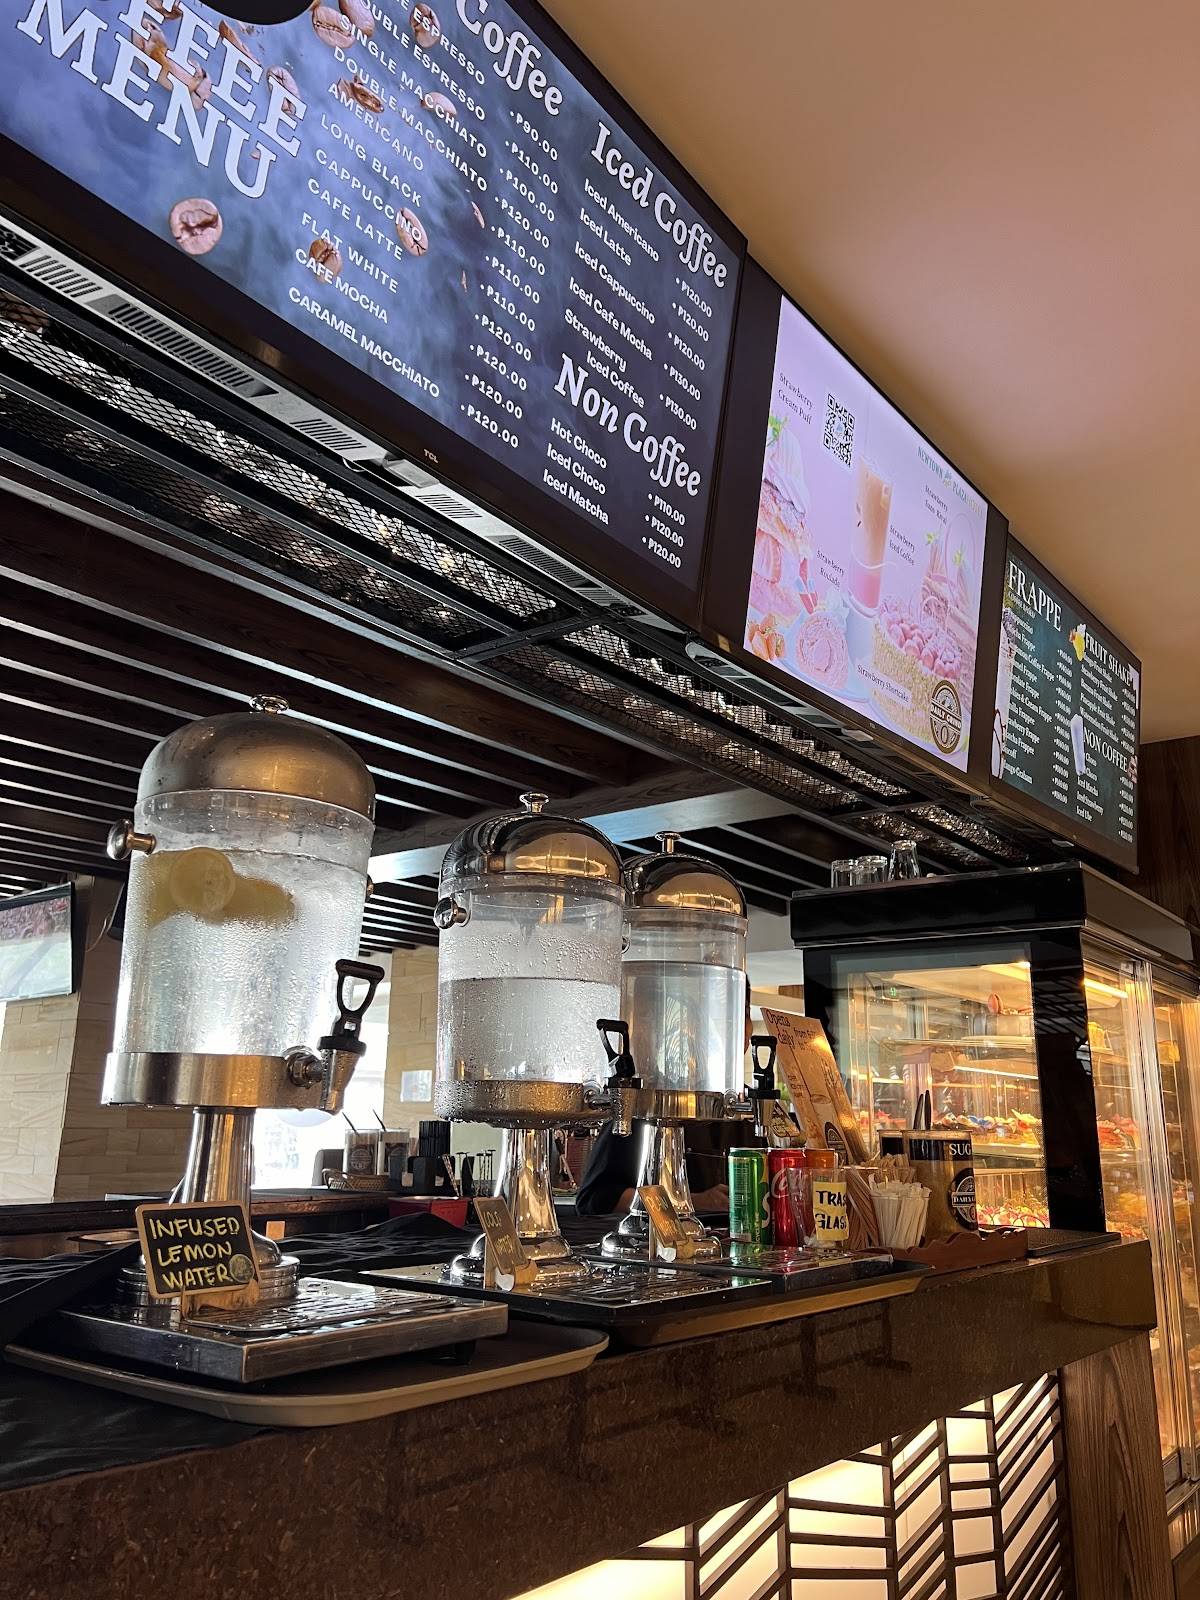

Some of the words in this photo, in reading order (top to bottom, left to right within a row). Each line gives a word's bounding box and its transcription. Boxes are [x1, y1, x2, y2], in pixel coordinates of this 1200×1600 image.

[413, 7, 485, 85] ESPRESSO
[456, 0, 563, 116] Coffee
[17, 0, 277, 198] MENU
[340, 14, 397, 74] SINGLE
[401, 71, 487, 158] MACCHIATO
[413, 45, 486, 121] ESPRESSO
[328, 83, 424, 171] AMERICANO
[333, 46, 397, 111] DOUBLE
[401, 109, 488, 192] MACCHIATO
[320, 113, 367, 161] LONG
[371, 158, 422, 208] BLACK
[307, 178, 351, 220] CAFE
[355, 215, 403, 260] LATTE
[315, 149, 422, 242] CAPPUCCINO
[584, 178, 608, 211] Iced
[607, 204, 660, 262] Americano
[591, 121, 655, 208] Iced
[654, 192, 728, 288] Coffee
[301, 212, 344, 250] FLAT
[348, 246, 399, 295] WHITE
[579, 208, 603, 239] Iced
[603, 230, 632, 266] Latte
[295, 248, 334, 285] CAFE
[335, 277, 389, 324] MOCHA
[574, 241, 598, 271] Iced
[598, 263, 655, 324] Cappuccino
[288, 287, 358, 344] CARAMEL
[360, 335, 440, 398] MACCHIATO
[564, 308, 627, 373] Strawberry
[569, 276, 593, 306] Iced
[594, 299, 620, 331] Cafe
[620, 321, 653, 361] Mocha
[586, 350, 609, 379] Iced
[609, 371, 645, 409] Coffee
[778, 389, 798, 413] Cream
[799, 407, 812, 425] Puff
[779, 372, 813, 410] Strawberry
[550, 417, 573, 444] Hot
[573, 435, 607, 469] Choco
[553, 352, 620, 433] Non
[623, 412, 701, 497] Coffee
[423, 448, 439, 464] TCL
[546, 443, 571, 472] Iced
[572, 462, 606, 495] Choco
[917, 446, 944, 480] NEWTOWN
[952, 481, 967, 504] PLAZA
[543, 468, 567, 496] Iced
[568, 486, 610, 525] Matcha
[925, 484, 948, 513] Strawberry
[816, 550, 844, 577] Strawberry
[889, 525, 915, 553] Strawberry
[1008, 560, 1062, 632] FRAPPE
[857, 664, 886, 690] Strawberry
[1085, 631, 1108, 664] FRUIT
[1108, 653, 1132, 687] SHAKE
[930, 704, 945, 719] DAILY
[1024, 696, 1038, 713] Cream
[1083, 726, 1101, 753] NON
[1102, 742, 1128, 773] COFFEE
[149, 1217, 240, 1240] INFUSED
[157, 1241, 232, 1267] LEMON
[162, 1264, 233, 1289] WATER
